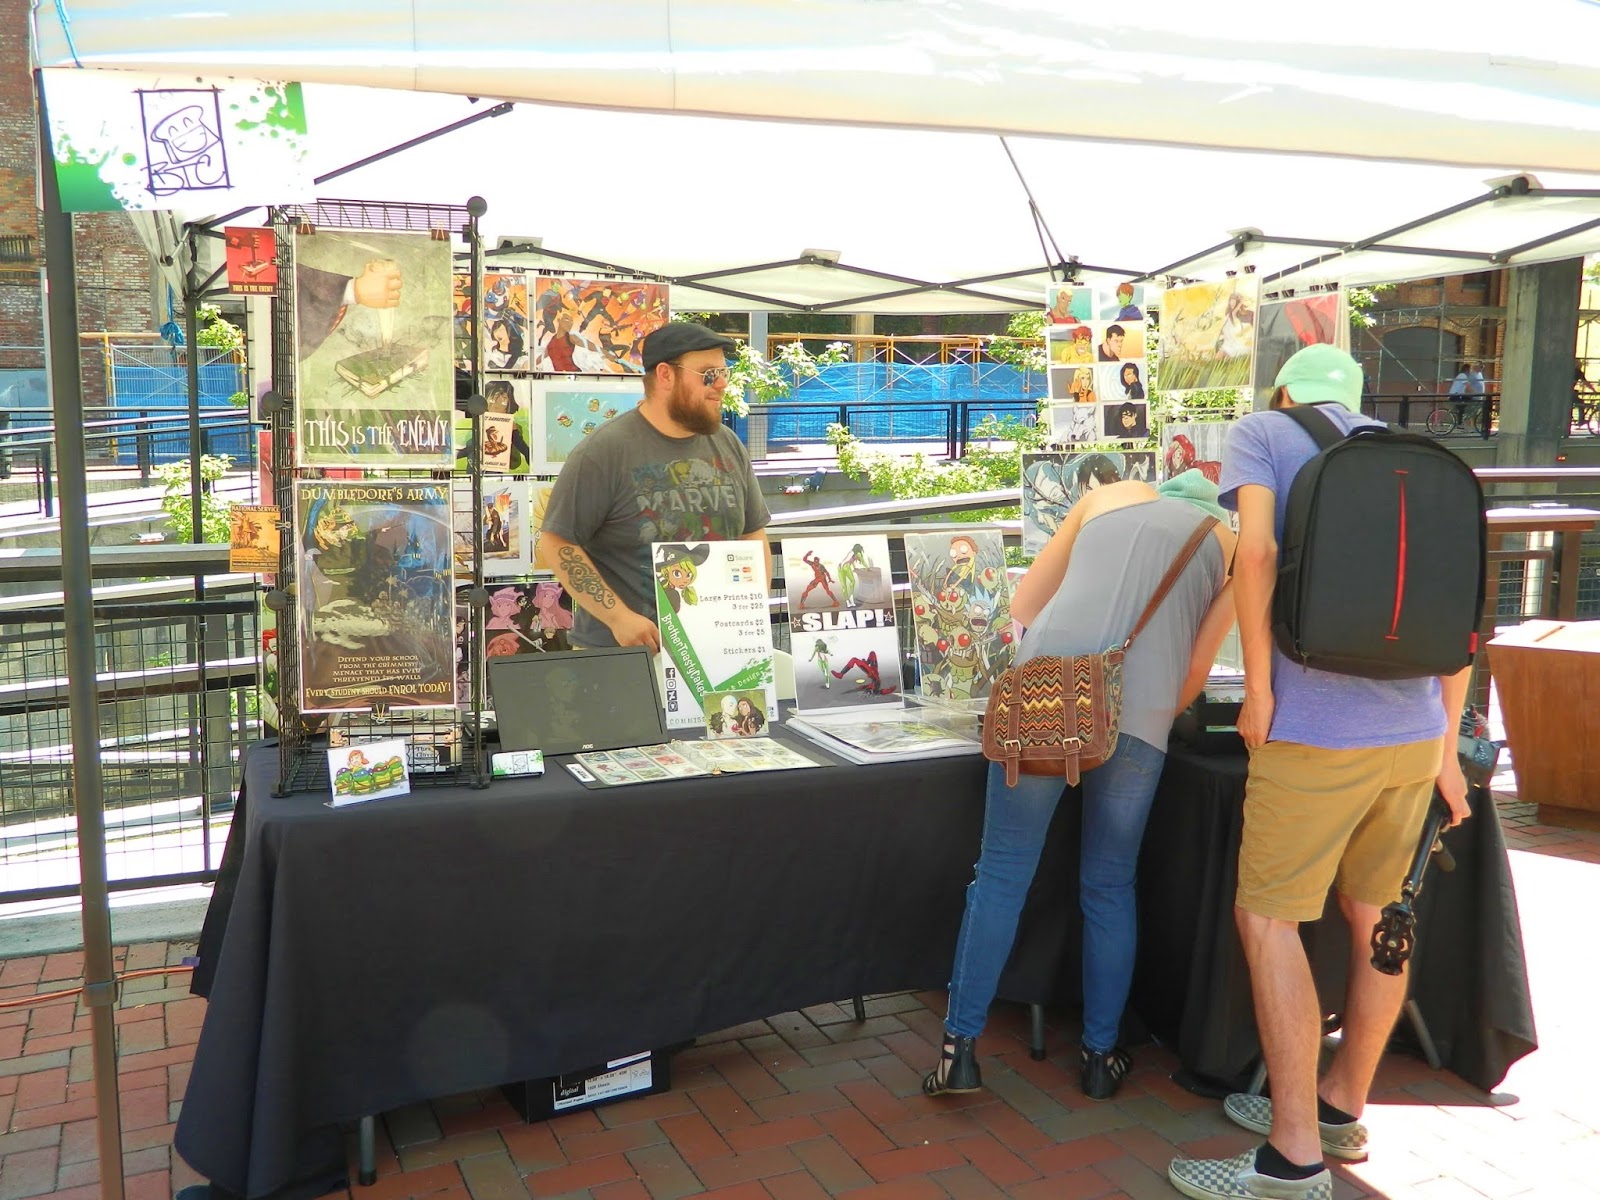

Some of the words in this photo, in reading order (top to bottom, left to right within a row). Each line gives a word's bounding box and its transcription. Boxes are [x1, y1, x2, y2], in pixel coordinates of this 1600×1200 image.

[140, 153, 226, 196] BTC
[304, 414, 350, 447] THIS
[351, 425, 366, 445] IS
[367, 422, 395, 445] THE
[396, 414, 449, 452] ENEMY
[301, 486, 403, 501] DUMBLEDORE'S
[406, 486, 449, 500] ARMY
[636, 485, 738, 513] MARVE
[700, 595, 722, 603] Large
[750, 602, 764, 610] $25
[714, 620, 754, 628] Postcards
[801, 608, 885, 632] SLAP!
[756, 628, 765, 636] $5
[723, 647, 756, 655] Stickers
[332, 675, 380, 683] THREATENED
[306, 687, 328, 698] EVERY
[330, 687, 361, 697] STUDENT
[361, 686, 387, 695] SHOULD
[388, 683, 417, 696] ENROL
[419, 681, 451, 694] TODAY!
[669, 716, 705, 725] COMMISS
